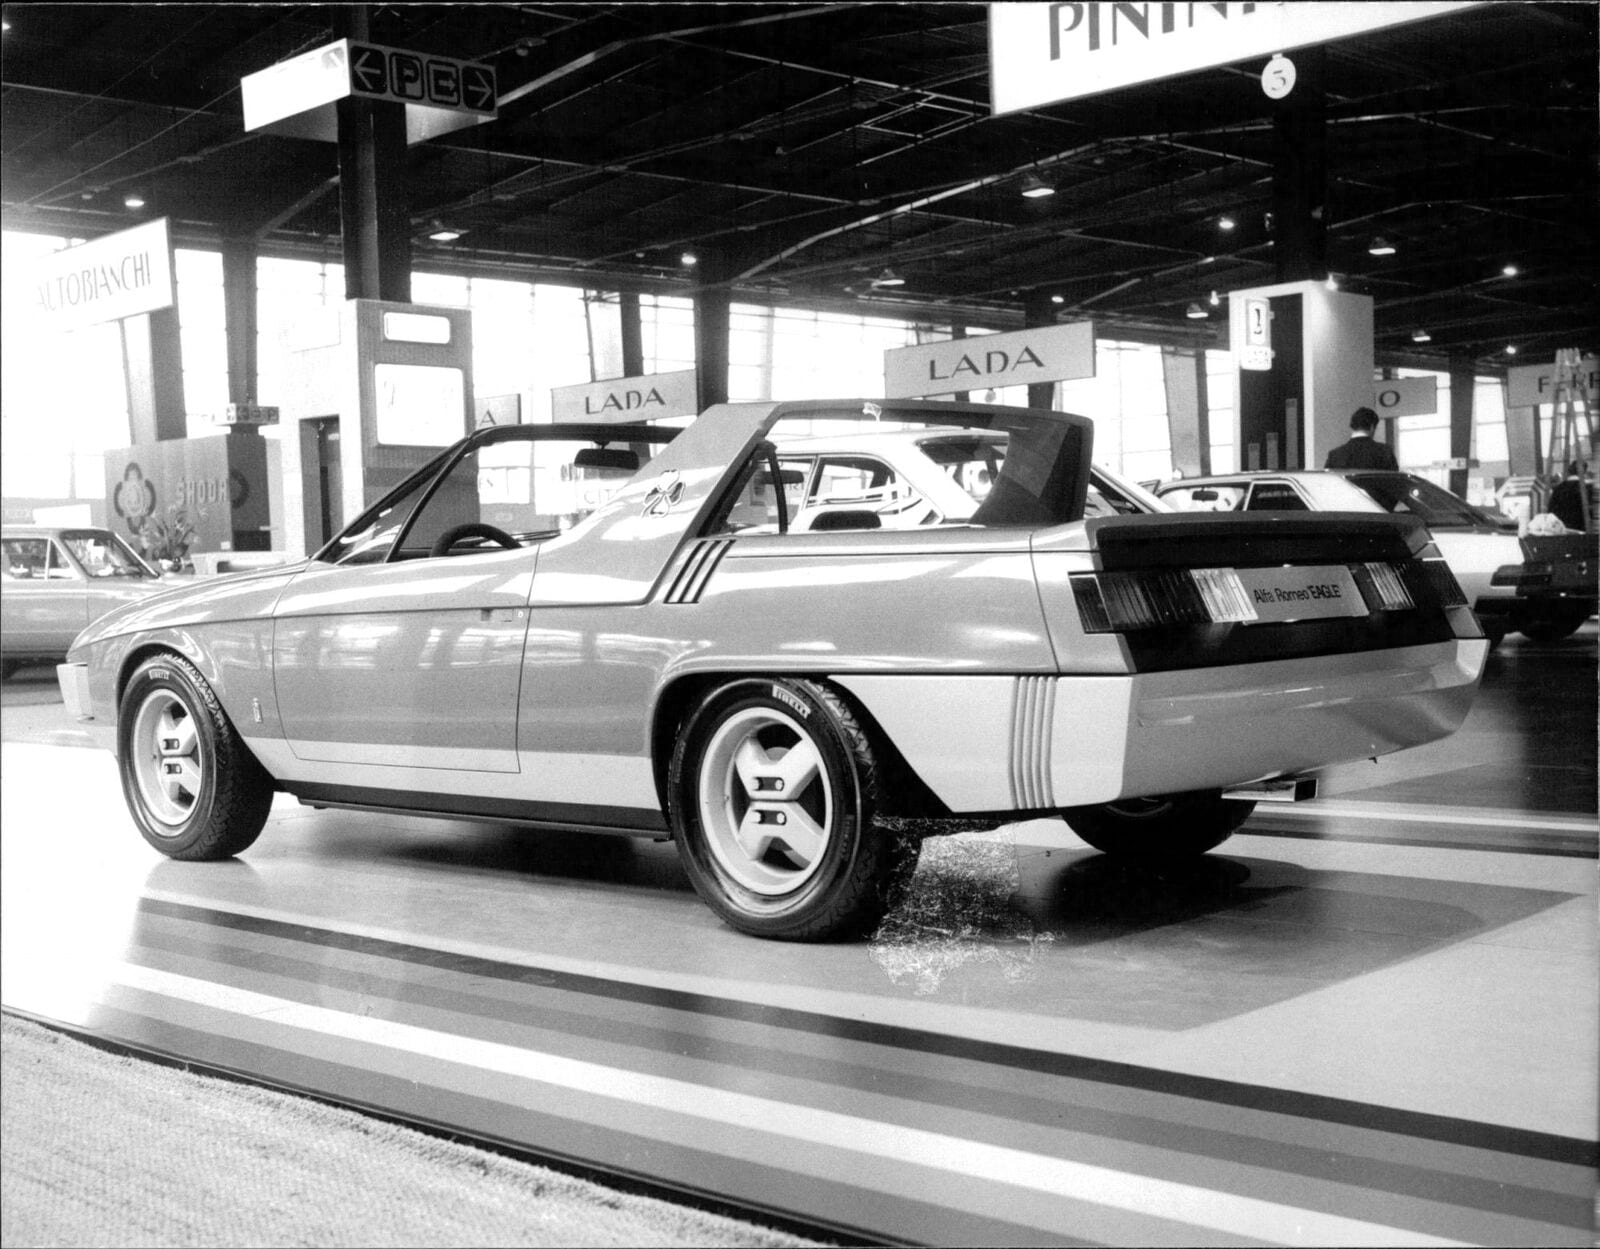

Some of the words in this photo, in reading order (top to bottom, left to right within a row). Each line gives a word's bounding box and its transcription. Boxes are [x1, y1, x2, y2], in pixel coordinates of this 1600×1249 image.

[1049, 2, 1256, 61] PINI
[929, 345, 1045, 380] LADA
[585, 387, 666, 415] LADA
[1253, 589, 1275, 603] Alfa
[1274, 587, 1309, 602] Romeo
